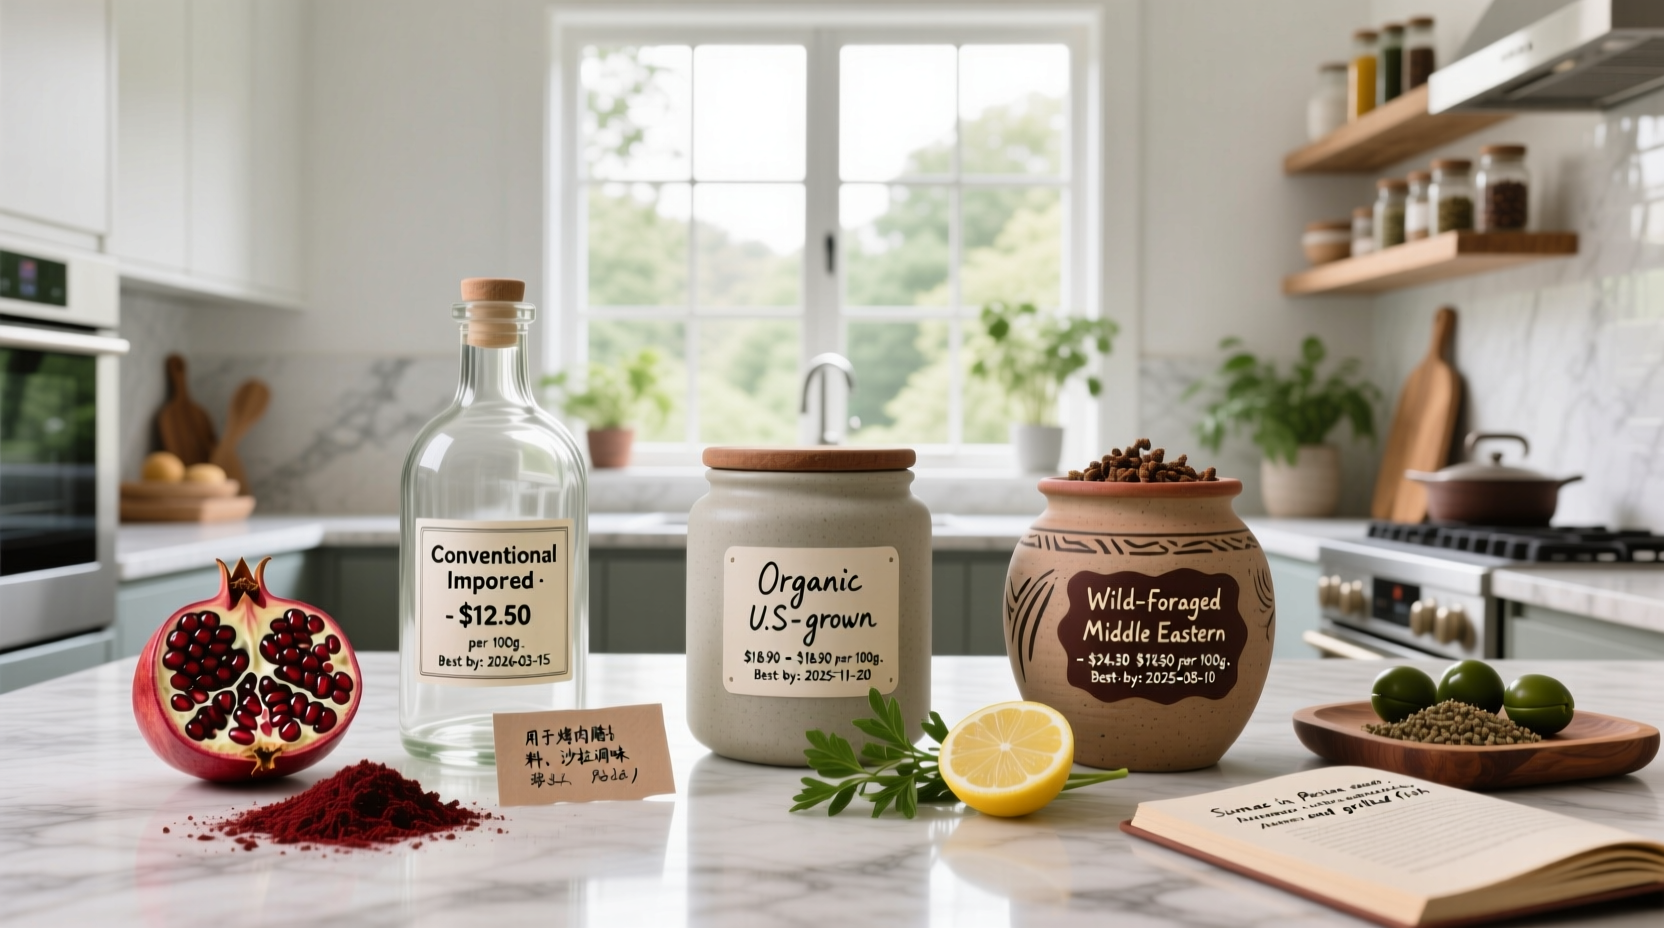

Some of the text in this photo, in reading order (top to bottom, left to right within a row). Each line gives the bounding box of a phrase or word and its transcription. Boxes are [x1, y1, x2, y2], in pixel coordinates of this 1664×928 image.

[431, 543, 557, 565] Conventional
[448, 570, 534, 595] Impored
[758, 561, 863, 610] Organic
[459, 601, 531, 629] $12.50
[749, 604, 877, 647] U.S-grown
[1082, 619, 1225, 643] Middle Eastern
[468, 639, 488, 652] per
[438, 654, 462, 667] Best
[466, 655, 484, 671] by:
[754, 668, 779, 681] Best
[782, 669, 801, 685] by:
[1123, 671, 1142, 688] by:
[1210, 802, 1271, 818] Sumac
